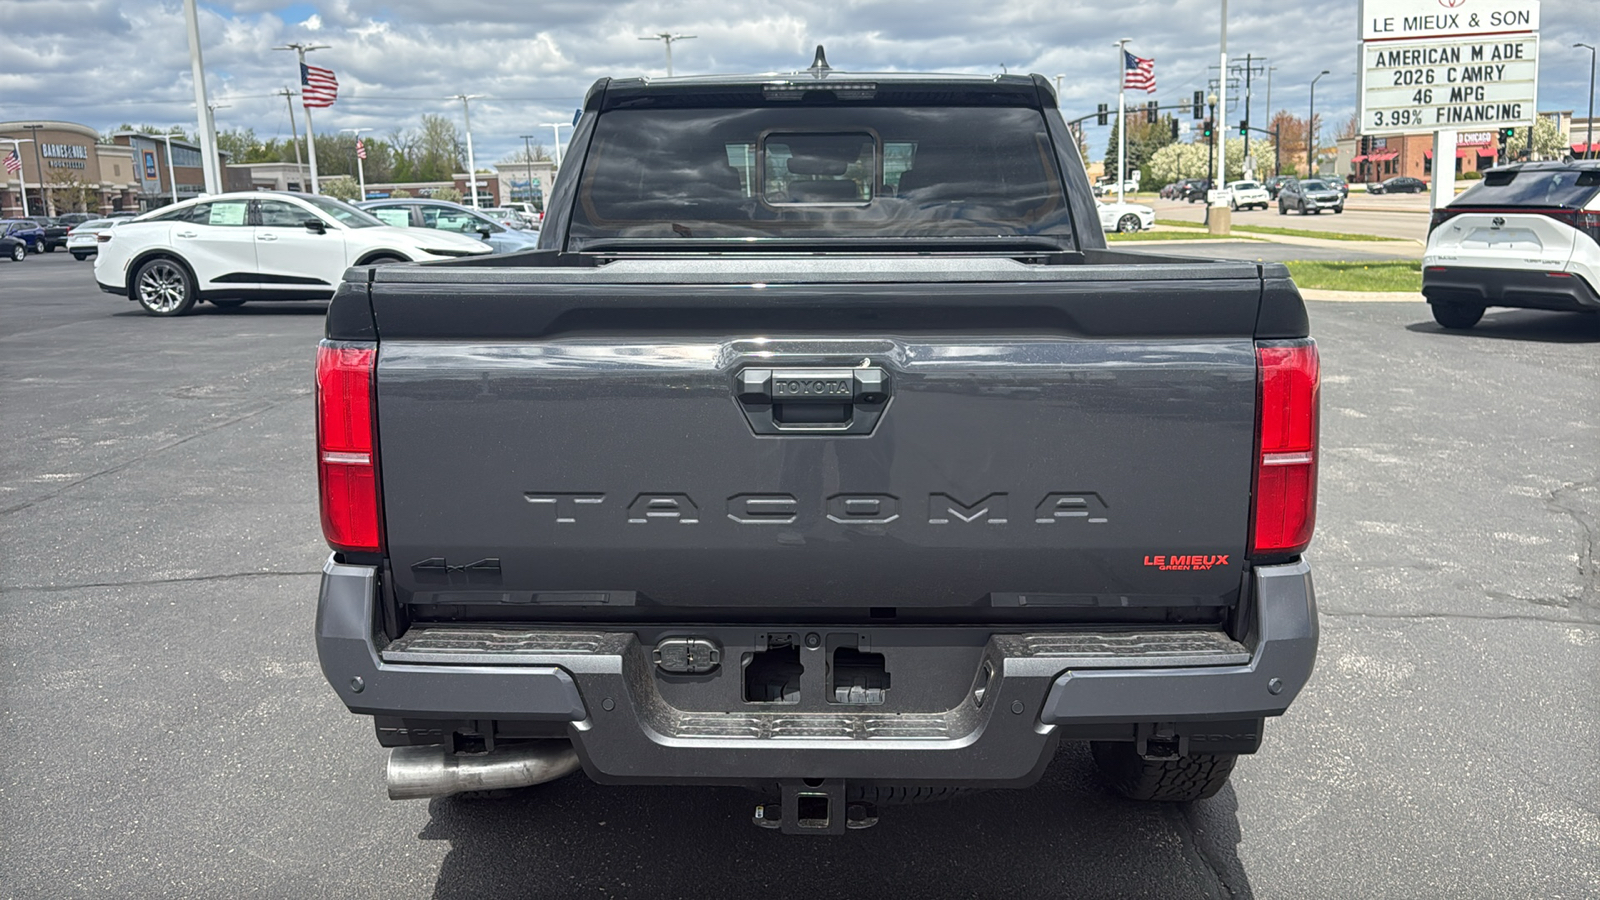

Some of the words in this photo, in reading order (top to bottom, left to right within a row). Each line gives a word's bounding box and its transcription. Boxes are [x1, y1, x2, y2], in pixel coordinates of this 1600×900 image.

[1373, 17, 1395, 33] LE
[1403, 14, 1459, 32] MIEUX
[1468, 13, 1480, 28] &
[1490, 10, 1530, 26] SON
[1375, 47, 1460, 68] AMERICAN
[1471, 43, 1523, 62] MADE
[1393, 69, 1435, 86] 2026
[1447, 64, 1506, 83] CAMRY
[1412, 89, 1433, 105] 46
[1450, 86, 1485, 103] MPG
[1374, 109, 1422, 127] 3.99%
[1435, 104, 1522, 123] FINANCING
[1464, 132, 1491, 143] CHICAGO
[42, 143, 68, 158] BARNES
[73, 145, 87, 159] NOBLE
[776, 380, 850, 394] TOYOTA
[523, 491, 1109, 526] TACOMA
[1143, 555, 1166, 565] LE
[1170, 554, 1229, 565] MIEUX
